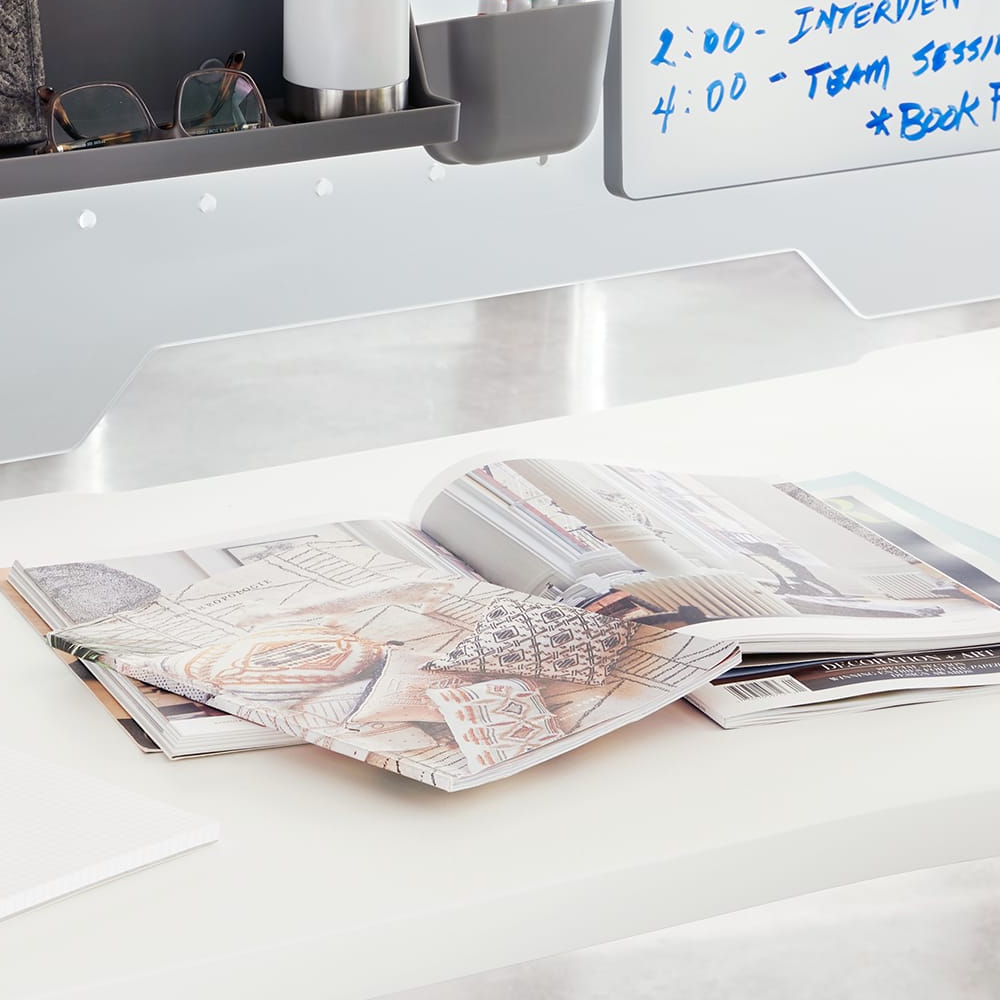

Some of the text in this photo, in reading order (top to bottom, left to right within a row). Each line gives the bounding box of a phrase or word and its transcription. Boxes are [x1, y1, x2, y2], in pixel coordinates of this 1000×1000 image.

[804, 56, 891, 99] TEAM
[821, 655, 942, 671] DECORATION
[961, 648, 995, 660] ART
